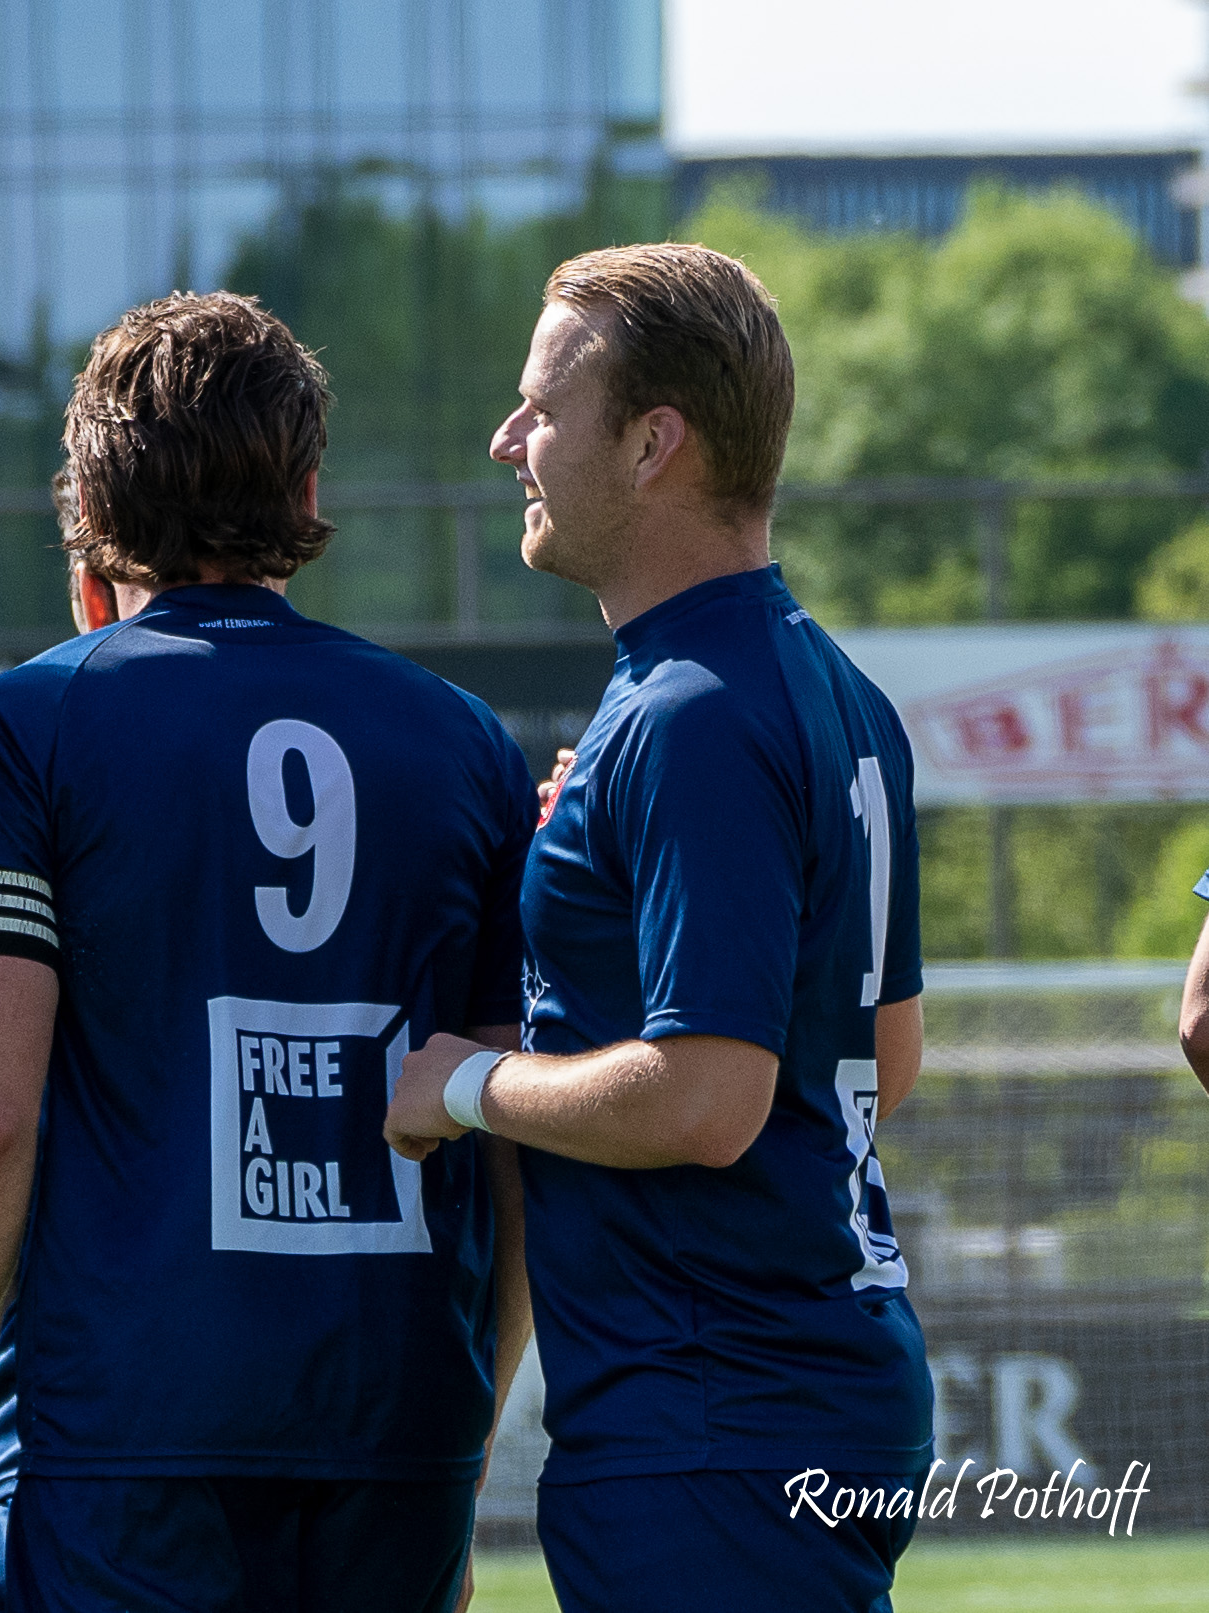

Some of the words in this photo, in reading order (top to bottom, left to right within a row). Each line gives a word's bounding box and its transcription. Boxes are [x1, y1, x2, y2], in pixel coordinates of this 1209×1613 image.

[246, 718, 357, 953] 9
[240, 1034, 344, 1098] FREE
[244, 1097, 274, 1155] A
[244, 1157, 351, 1218] GIRL
